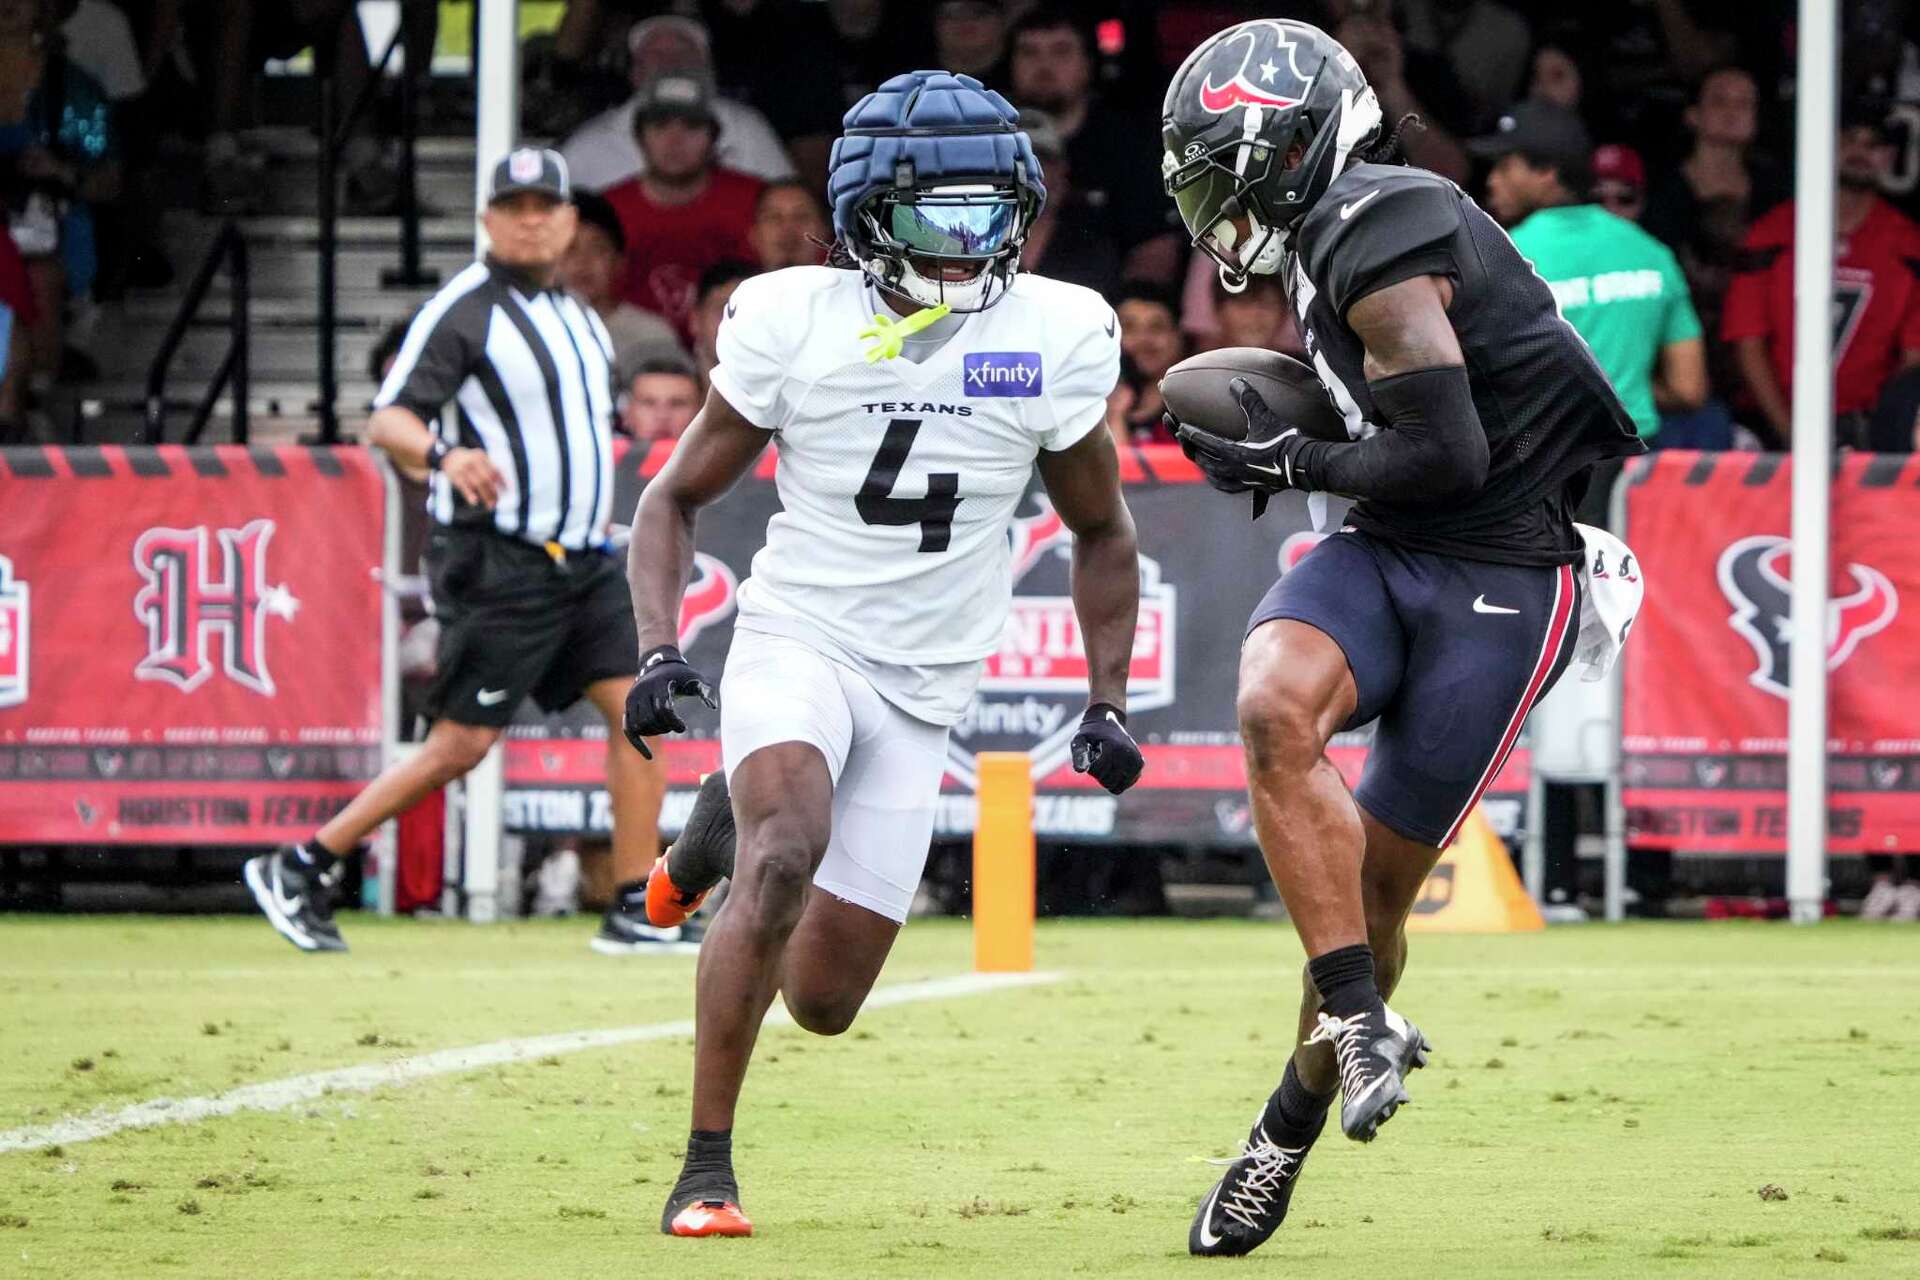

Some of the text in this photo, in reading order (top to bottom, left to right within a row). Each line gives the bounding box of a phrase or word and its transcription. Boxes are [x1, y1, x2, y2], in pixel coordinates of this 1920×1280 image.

[967, 361, 1039, 387] xfinity
[861, 402, 973, 417] TEXANS
[854, 419, 965, 553] 4
